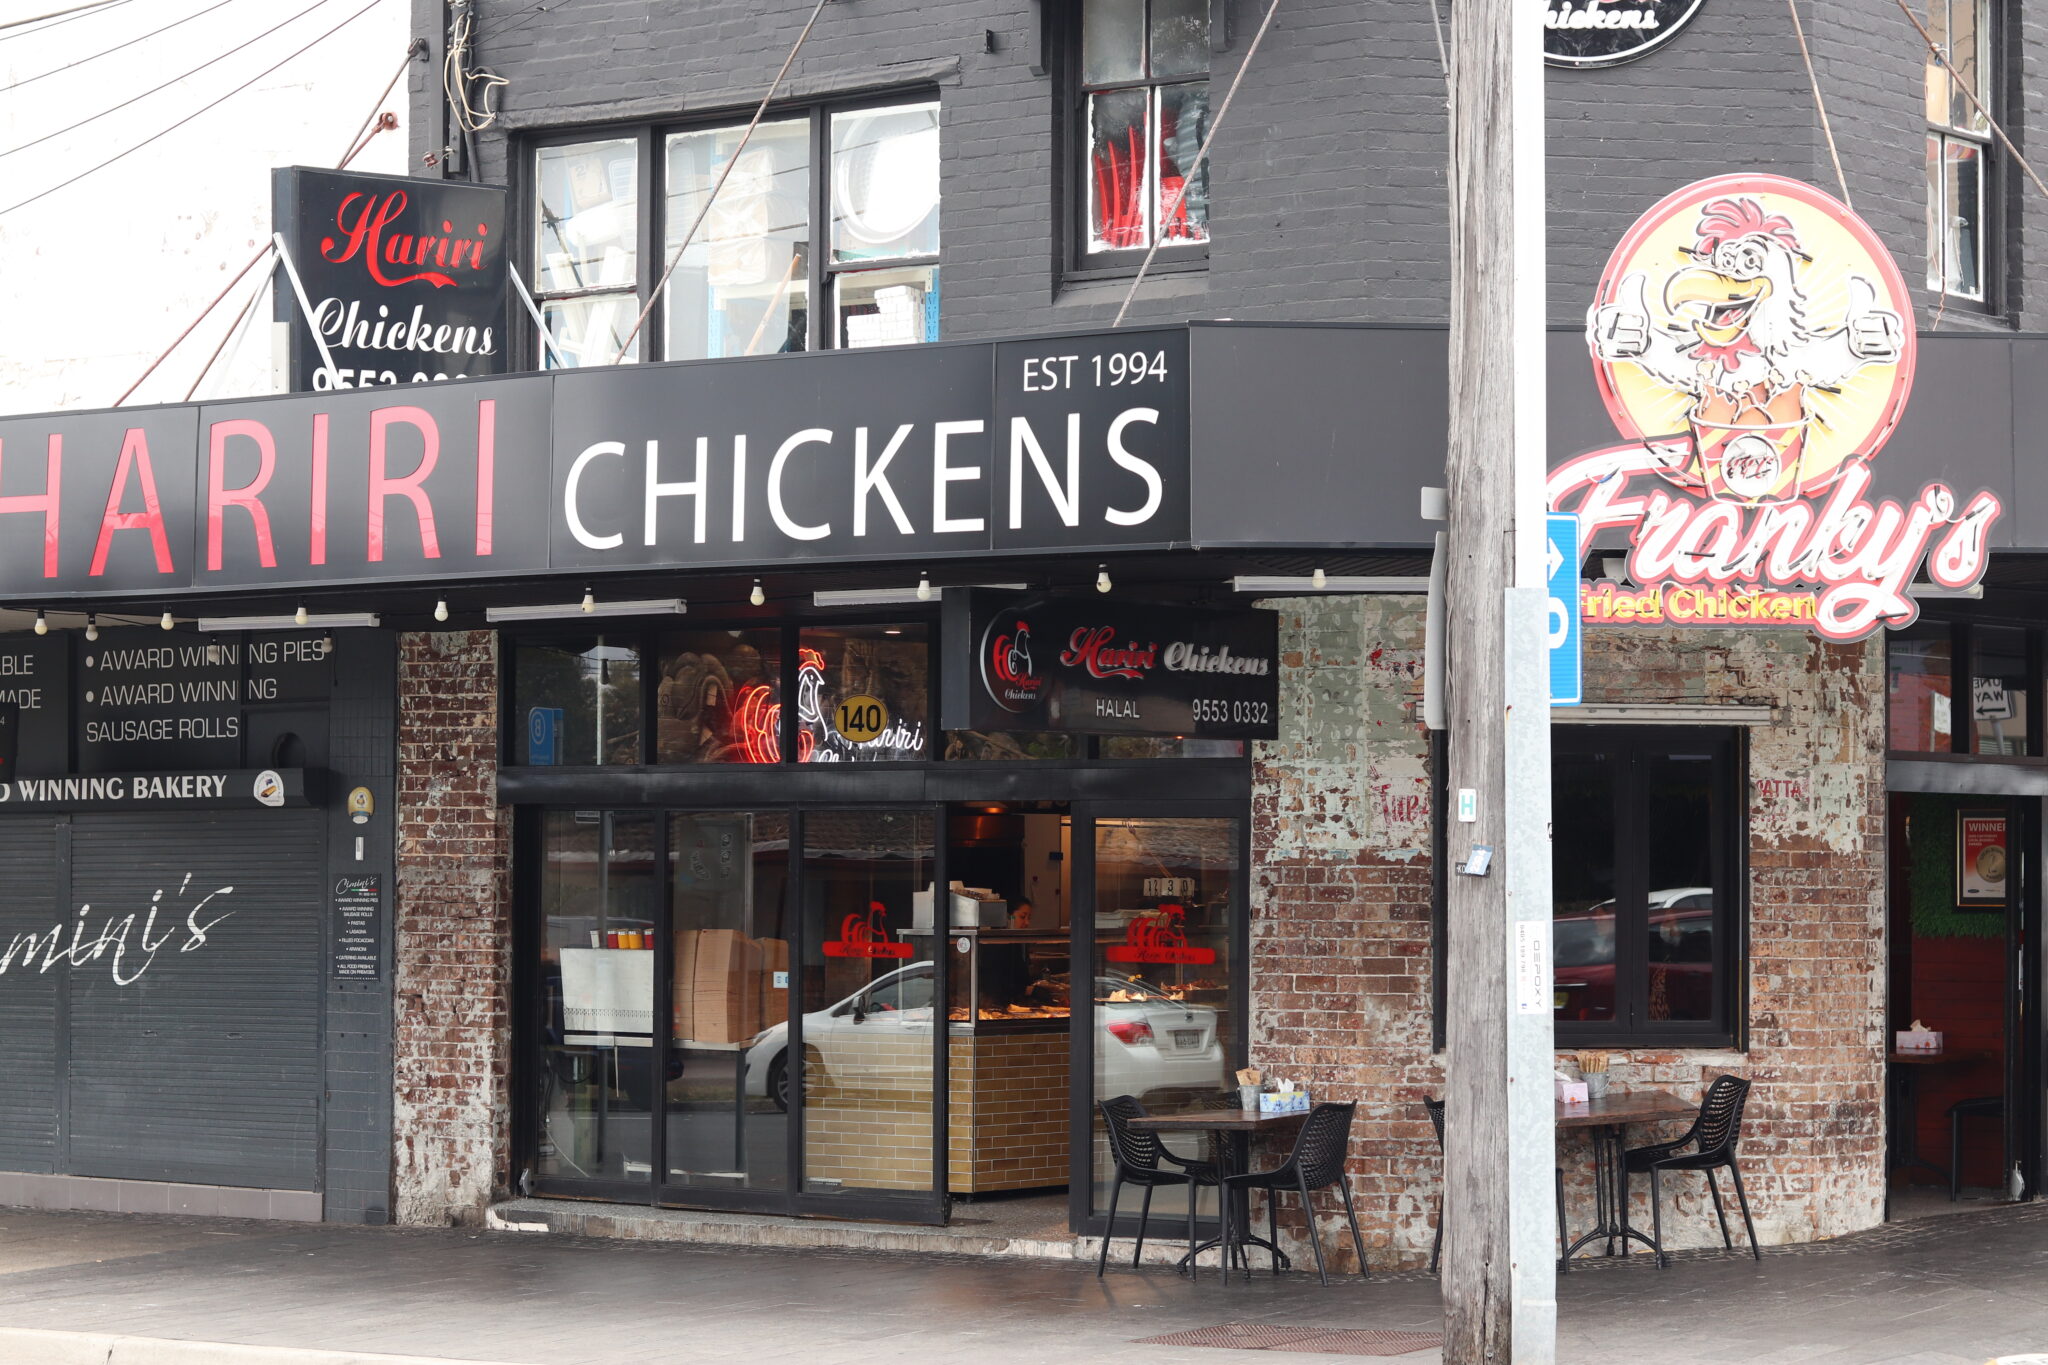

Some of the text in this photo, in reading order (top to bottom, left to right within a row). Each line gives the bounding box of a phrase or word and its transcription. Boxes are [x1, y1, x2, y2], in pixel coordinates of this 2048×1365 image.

[1544, 0, 1660, 29] hickens
[321, 190, 489, 289] Hariri
[313, 297, 497, 356] Chickens
[1022, 350, 1168, 392] EST 1994
[563, 406, 1164, 550] CHICKENS
[1547, 444, 1998, 632] Franky's
[1669, 588, 1816, 619] Chicken
[0, 654, 34, 676] BLE
[100, 647, 174, 671] AWARD
[283, 640, 325, 663] PIES
[1060, 625, 1271, 679] Hariri Chickens
[0, 688, 41, 709] ADE
[100, 679, 277, 707] AWARD WINNING
[841, 704, 881, 733] 140
[1096, 698, 1140, 719] HALAL
[1192, 698, 1268, 724] 9553 0332
[86, 717, 239, 742] SAUSAGE ROLLS
[18, 777, 125, 802] WINNING
[132, 775, 228, 800] BAKERY
[1461, 794, 1474, 815] H
